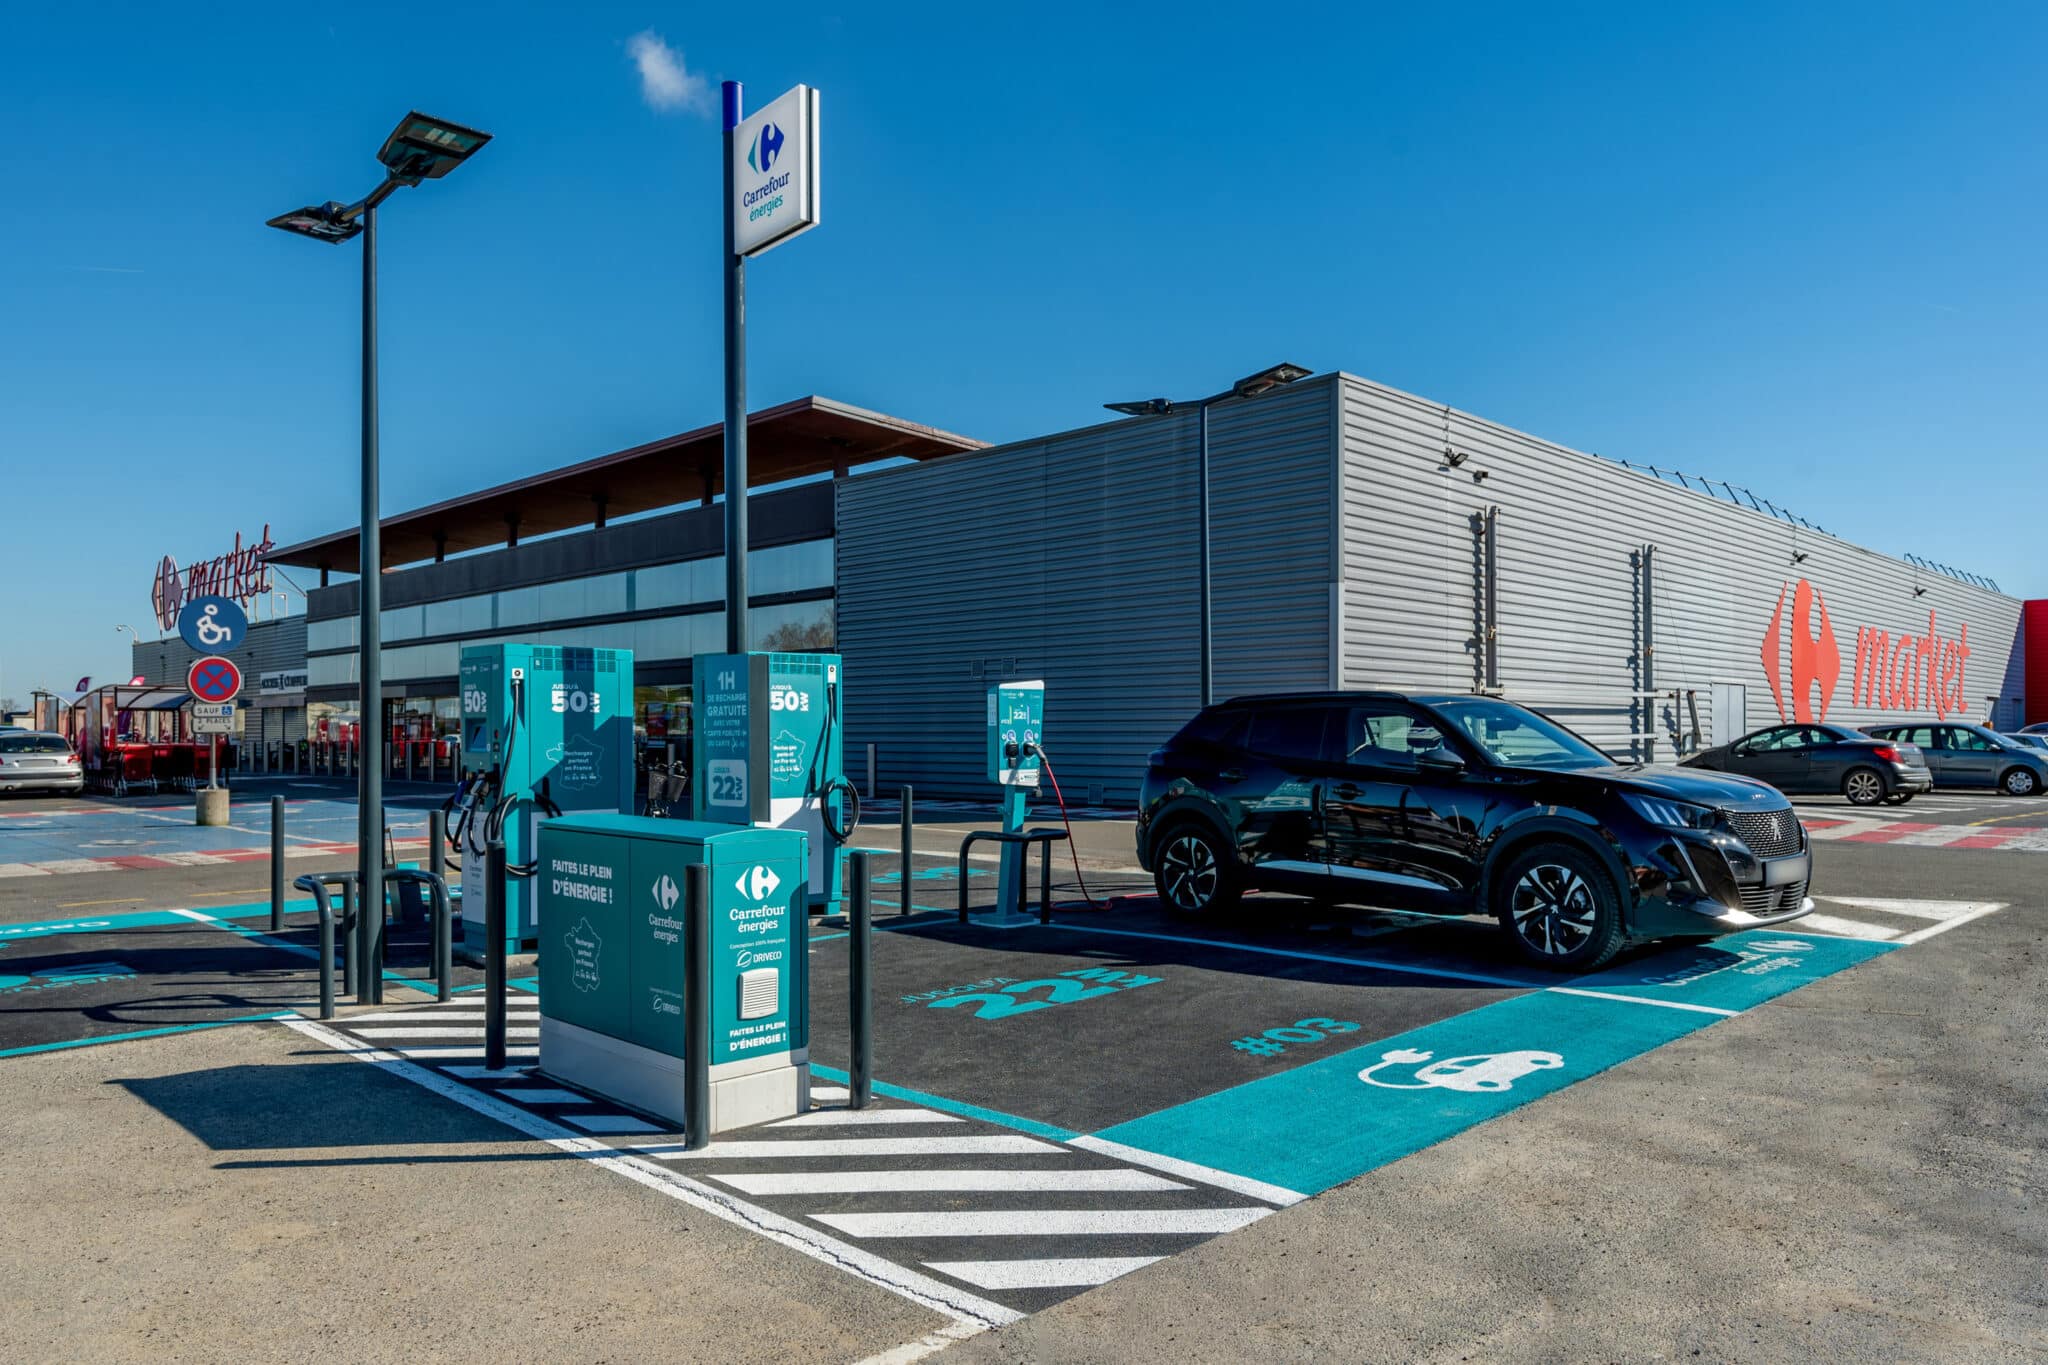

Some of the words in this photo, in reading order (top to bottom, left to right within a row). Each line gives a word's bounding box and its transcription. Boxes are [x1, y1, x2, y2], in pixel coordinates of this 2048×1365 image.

[743, 171, 790, 208] Carrefour
[749, 194, 783, 222] énergies
[187, 523, 273, 609] market
[1853, 608, 1971, 721] market
[718, 670, 735, 690] 1H
[464, 691, 480, 712] 50
[551, 690, 588, 712] 50
[590, 692, 600, 713] kW
[707, 704, 747, 716] GRATUITE
[770, 690, 799, 711] 50
[800, 692, 808, 711] kW
[712, 775, 735, 800] 22
[552, 859, 578, 874] FAITES
[579, 864, 588, 876] LE
[589, 864, 612, 880] PLEIN
[553, 877, 607, 903] D'ÉNERGIE
[609, 888, 613, 904] !
[648, 913, 683, 930] Carrefour
[729, 904, 786, 921] Carrefour
[653, 927, 678, 944] énergies
[738, 918, 778, 934] énergies
[753, 951, 783, 963] DRIVECO
[926, 978, 1123, 1020] 22
[729, 1027, 755, 1038] FAITES
[755, 1024, 764, 1032] LE
[765, 1021, 786, 1030] PLEIN
[1231, 1017, 1361, 1057] #03
[730, 1033, 781, 1051] D'ÉNERGIE
[782, 1031, 786, 1042] !
